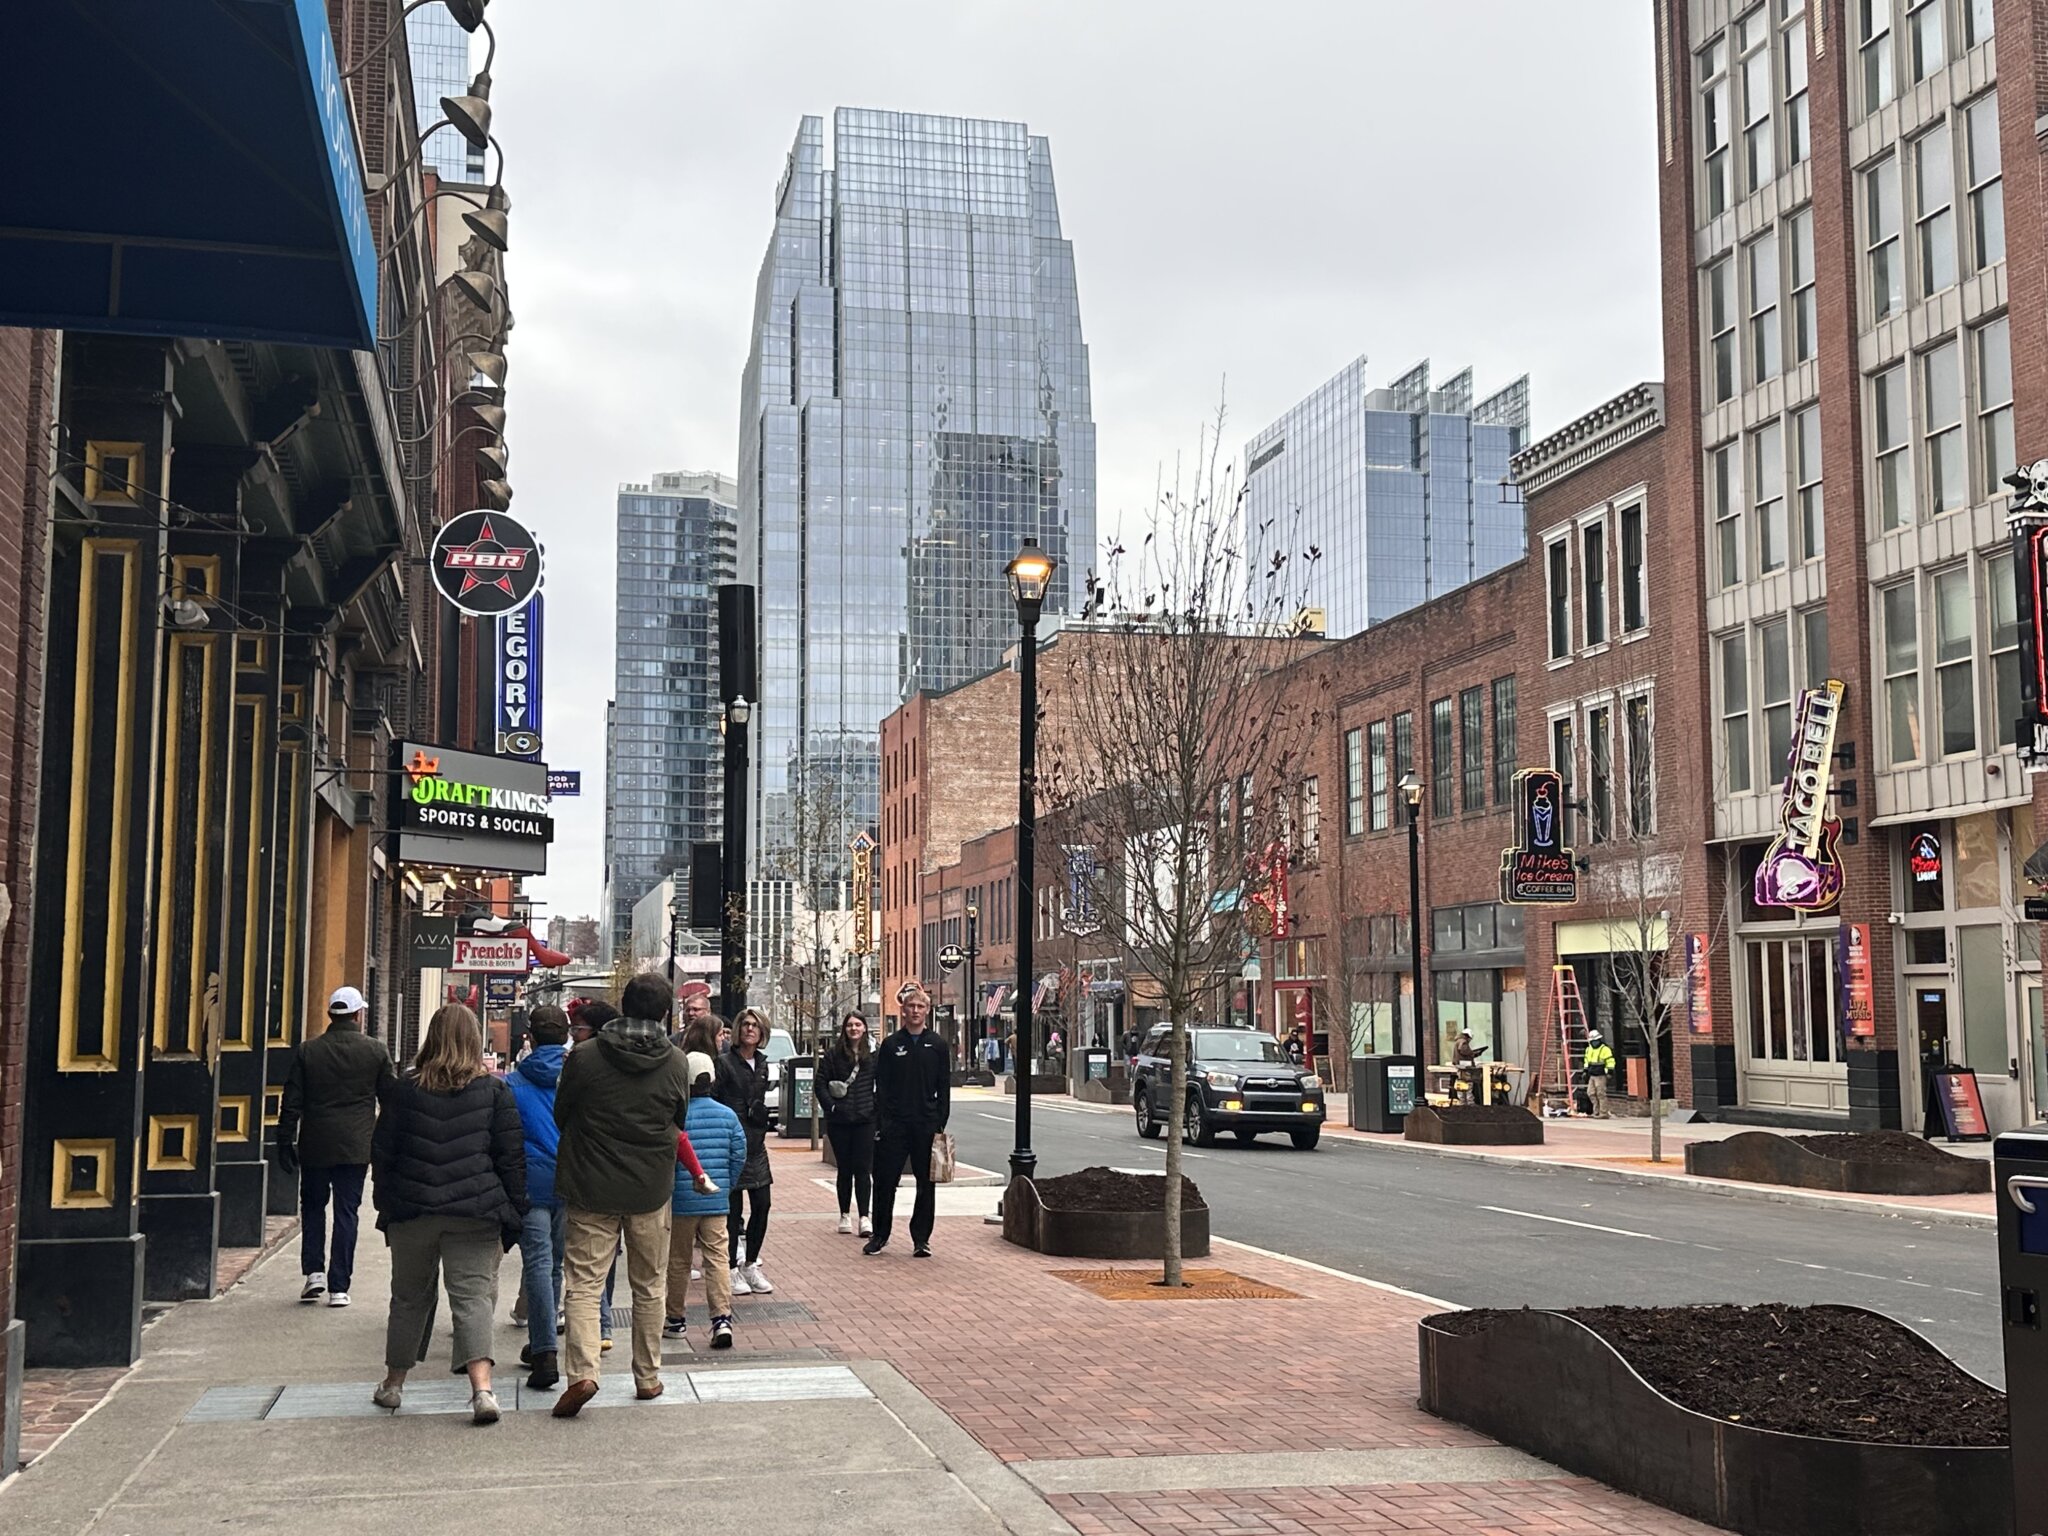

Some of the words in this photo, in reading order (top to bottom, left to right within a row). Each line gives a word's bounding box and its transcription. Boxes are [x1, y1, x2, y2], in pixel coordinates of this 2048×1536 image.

[451, 553, 521, 568] PBR
[505, 613, 528, 727] EGORY
[1803, 692, 1838, 765] BELL
[411, 776, 549, 816] DRAFTKINGS
[1786, 768, 1822, 850] TACO
[419, 807, 475, 828] SPORTS
[479, 816, 489, 829] &
[493, 817, 543, 836] SOCIAL
[1520, 854, 1569, 869] Mike's
[1516, 869, 1534, 881] Ice
[1535, 869, 1574, 882] Cream
[855, 851, 866, 945] CHIEFS
[1525, 885, 1554, 893] COFFEE
[1556, 885, 1572, 893] BAR
[413, 934, 451, 945] AVA
[454, 940, 523, 964] French's
[1848, 999, 1867, 1010] LIVE
[1846, 1009, 1872, 1020] MUSIC
